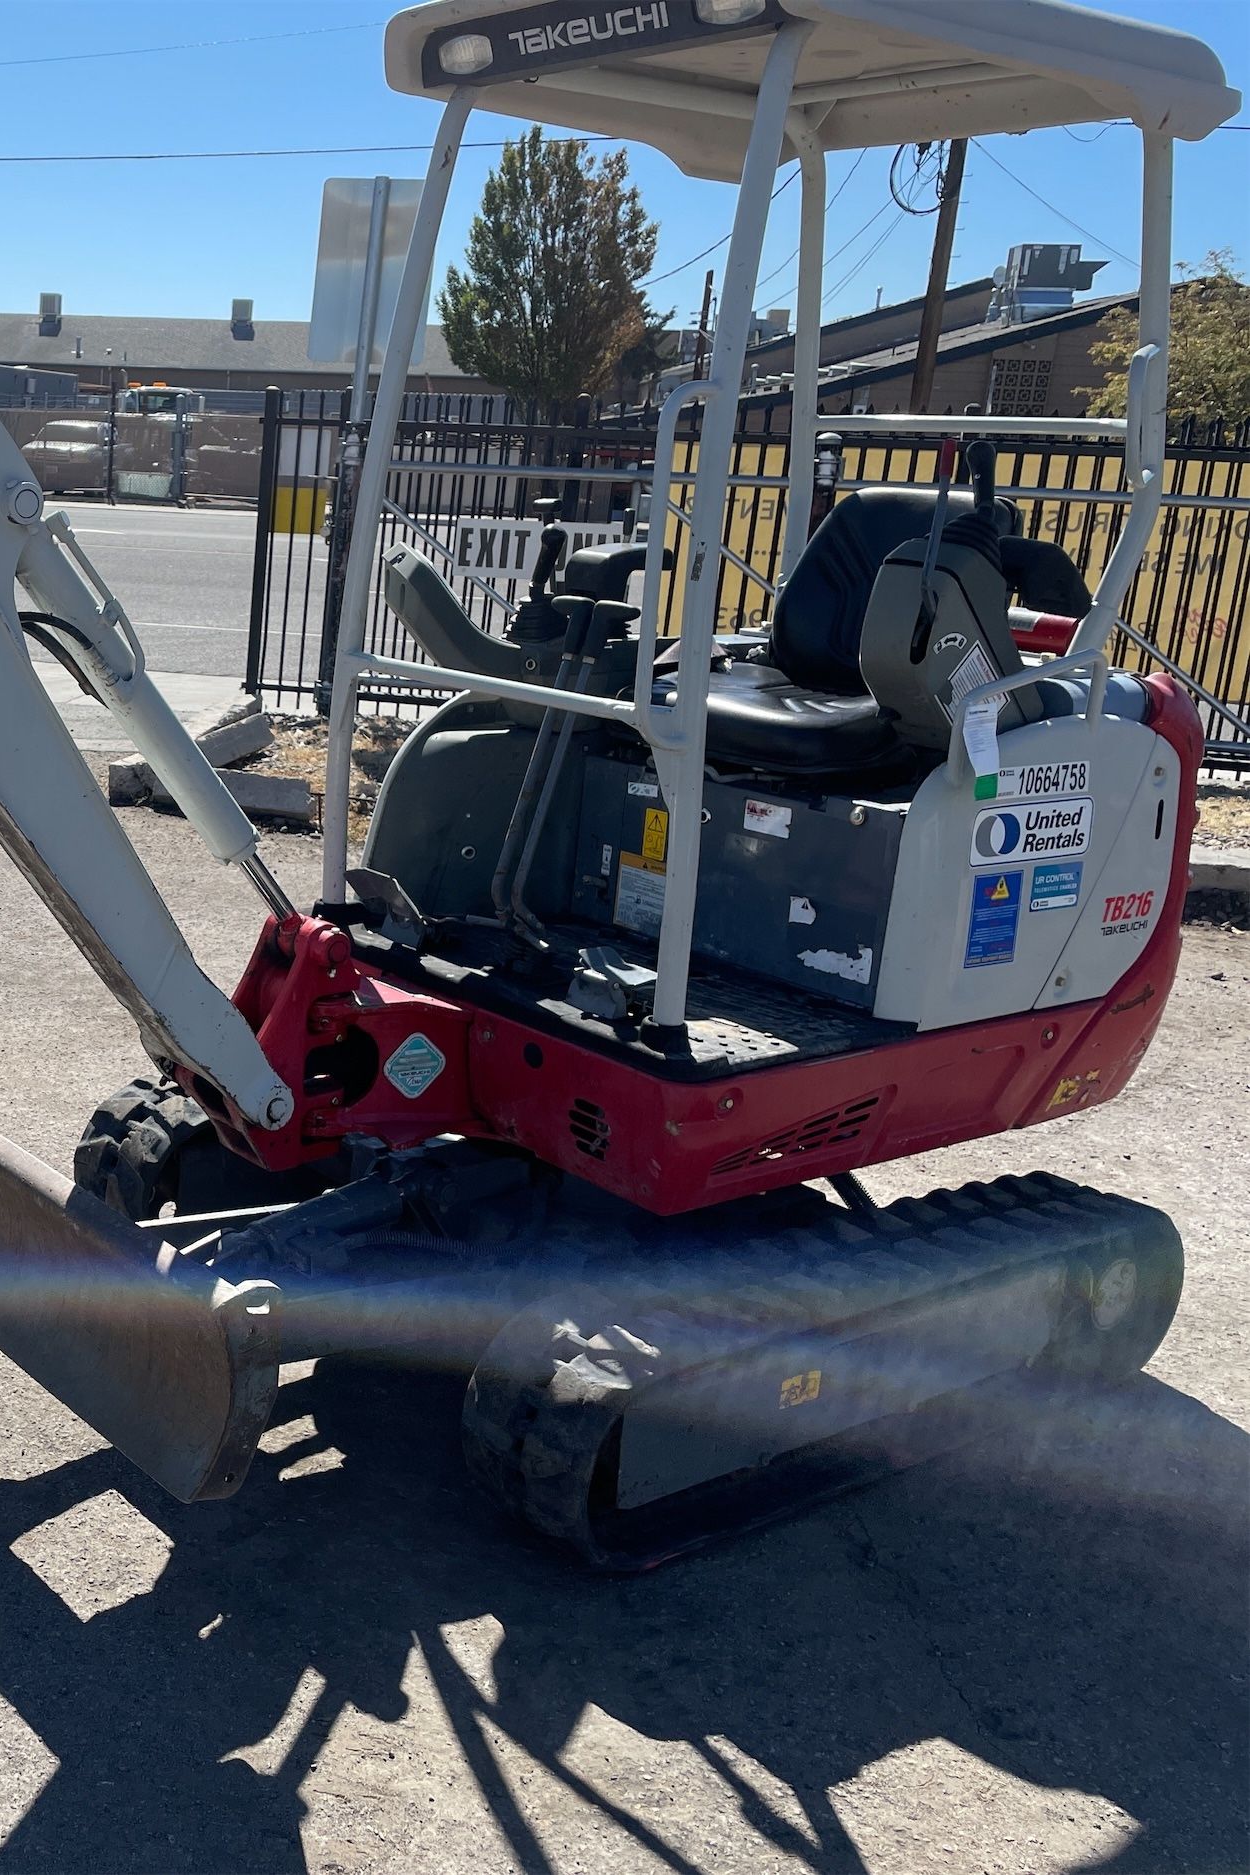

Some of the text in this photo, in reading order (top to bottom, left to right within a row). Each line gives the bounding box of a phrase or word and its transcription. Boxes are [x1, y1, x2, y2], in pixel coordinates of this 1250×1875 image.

[458, 528, 531, 570] EXIT
[1018, 763, 1086, 796] 10664758
[1025, 806, 1085, 831] United
[1022, 828, 1086, 854] Rentals
[1102, 890, 1154, 923] TB216
